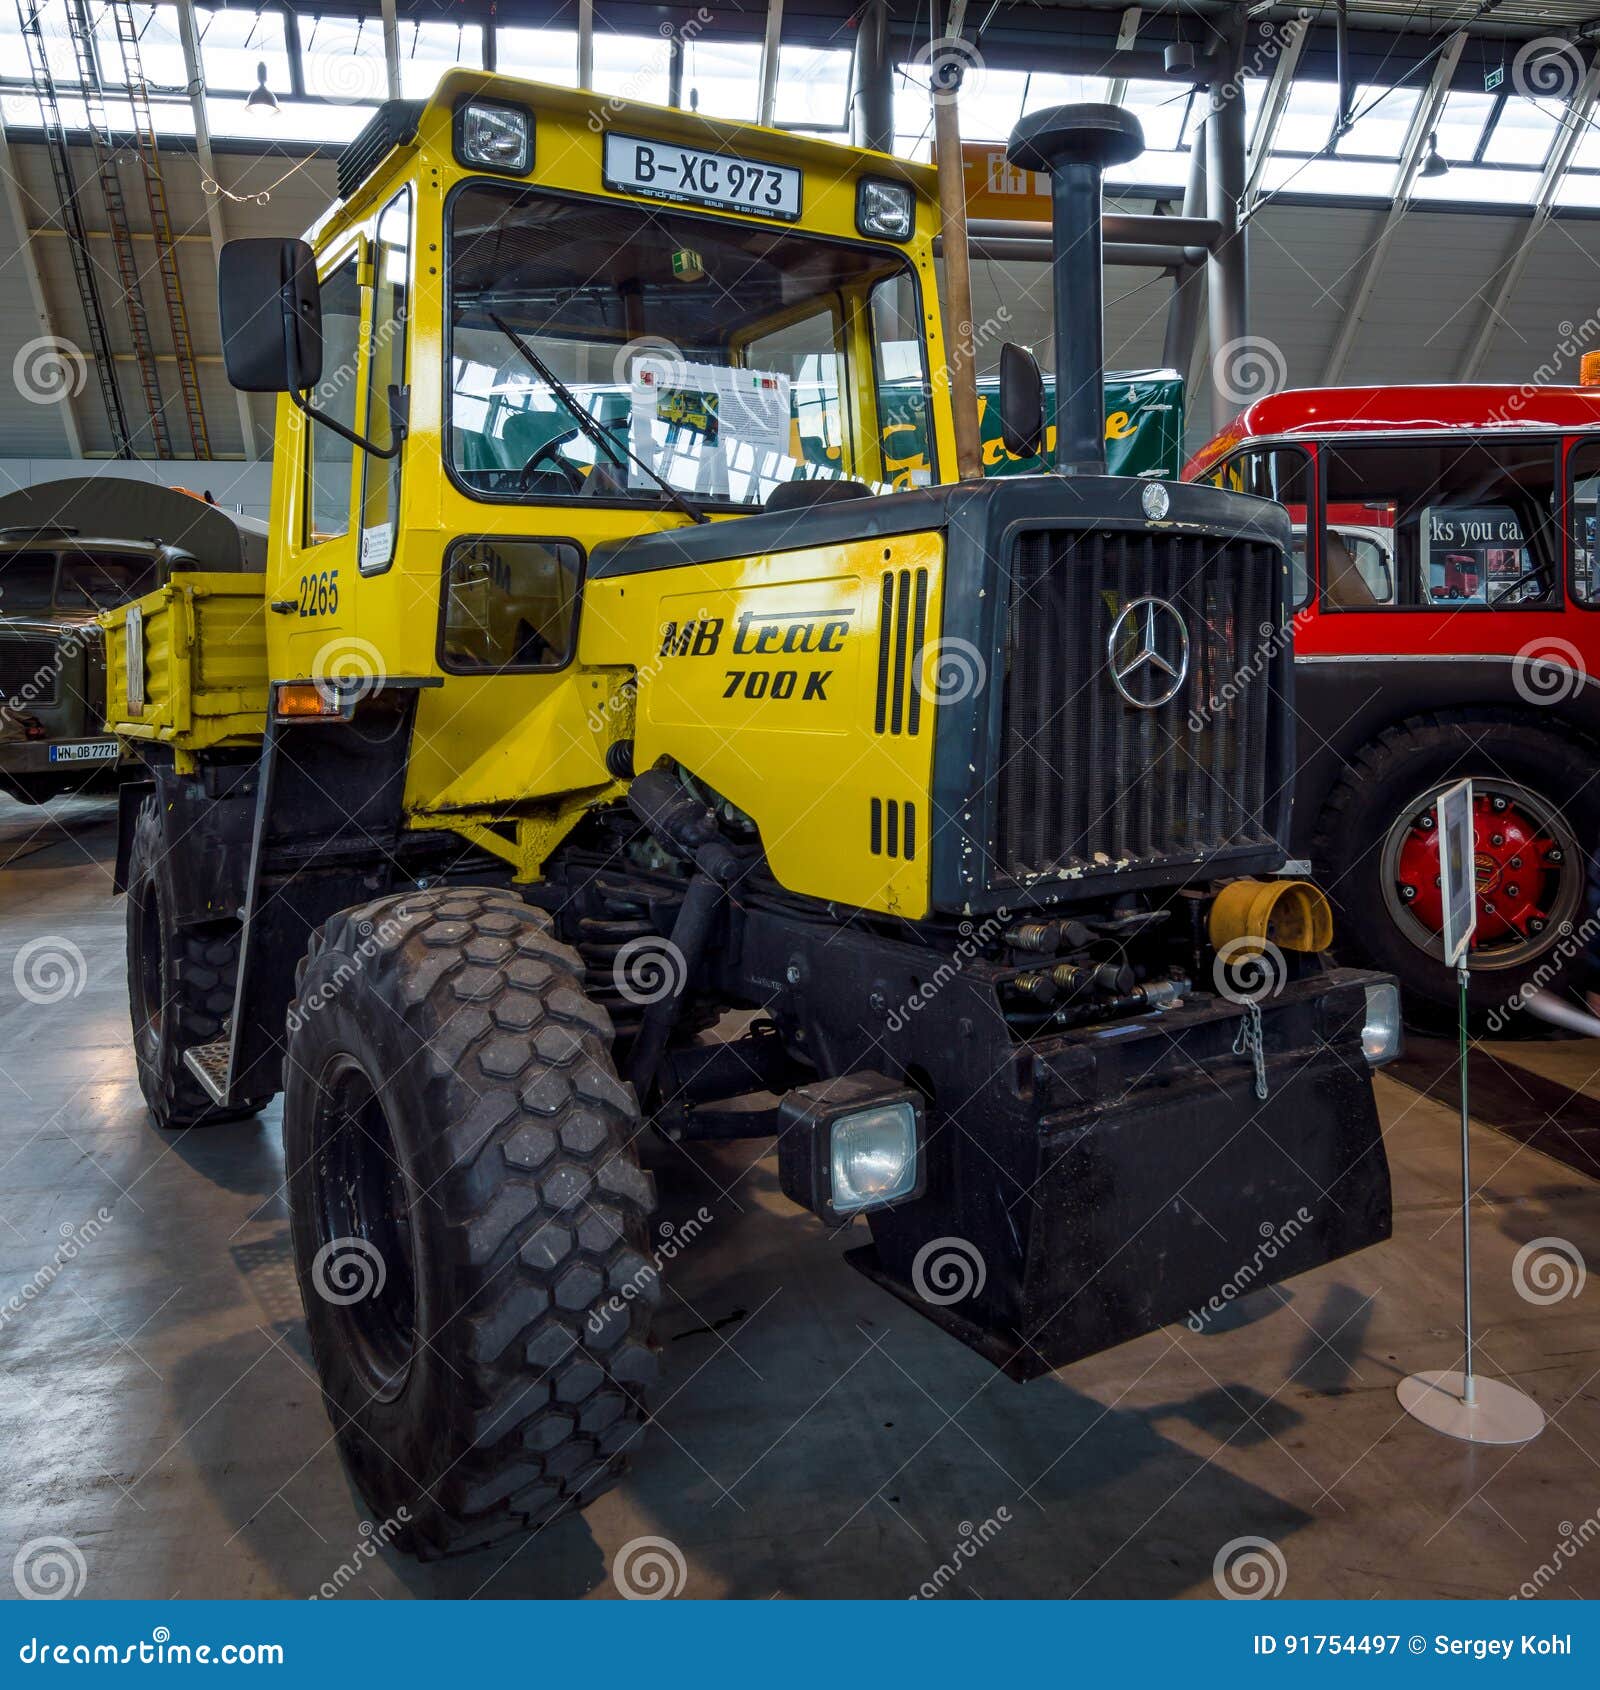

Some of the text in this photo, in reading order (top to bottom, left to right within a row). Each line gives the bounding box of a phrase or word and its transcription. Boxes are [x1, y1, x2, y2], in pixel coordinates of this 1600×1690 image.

[635, 145, 783, 205] B-XC 973
[1460, 521, 1494, 547] you
[300, 569, 339, 617] 2265
[659, 608, 856, 656] MB trac
[722, 670, 833, 700] 700 K
[57, 744, 118, 759] WN OB 777H
